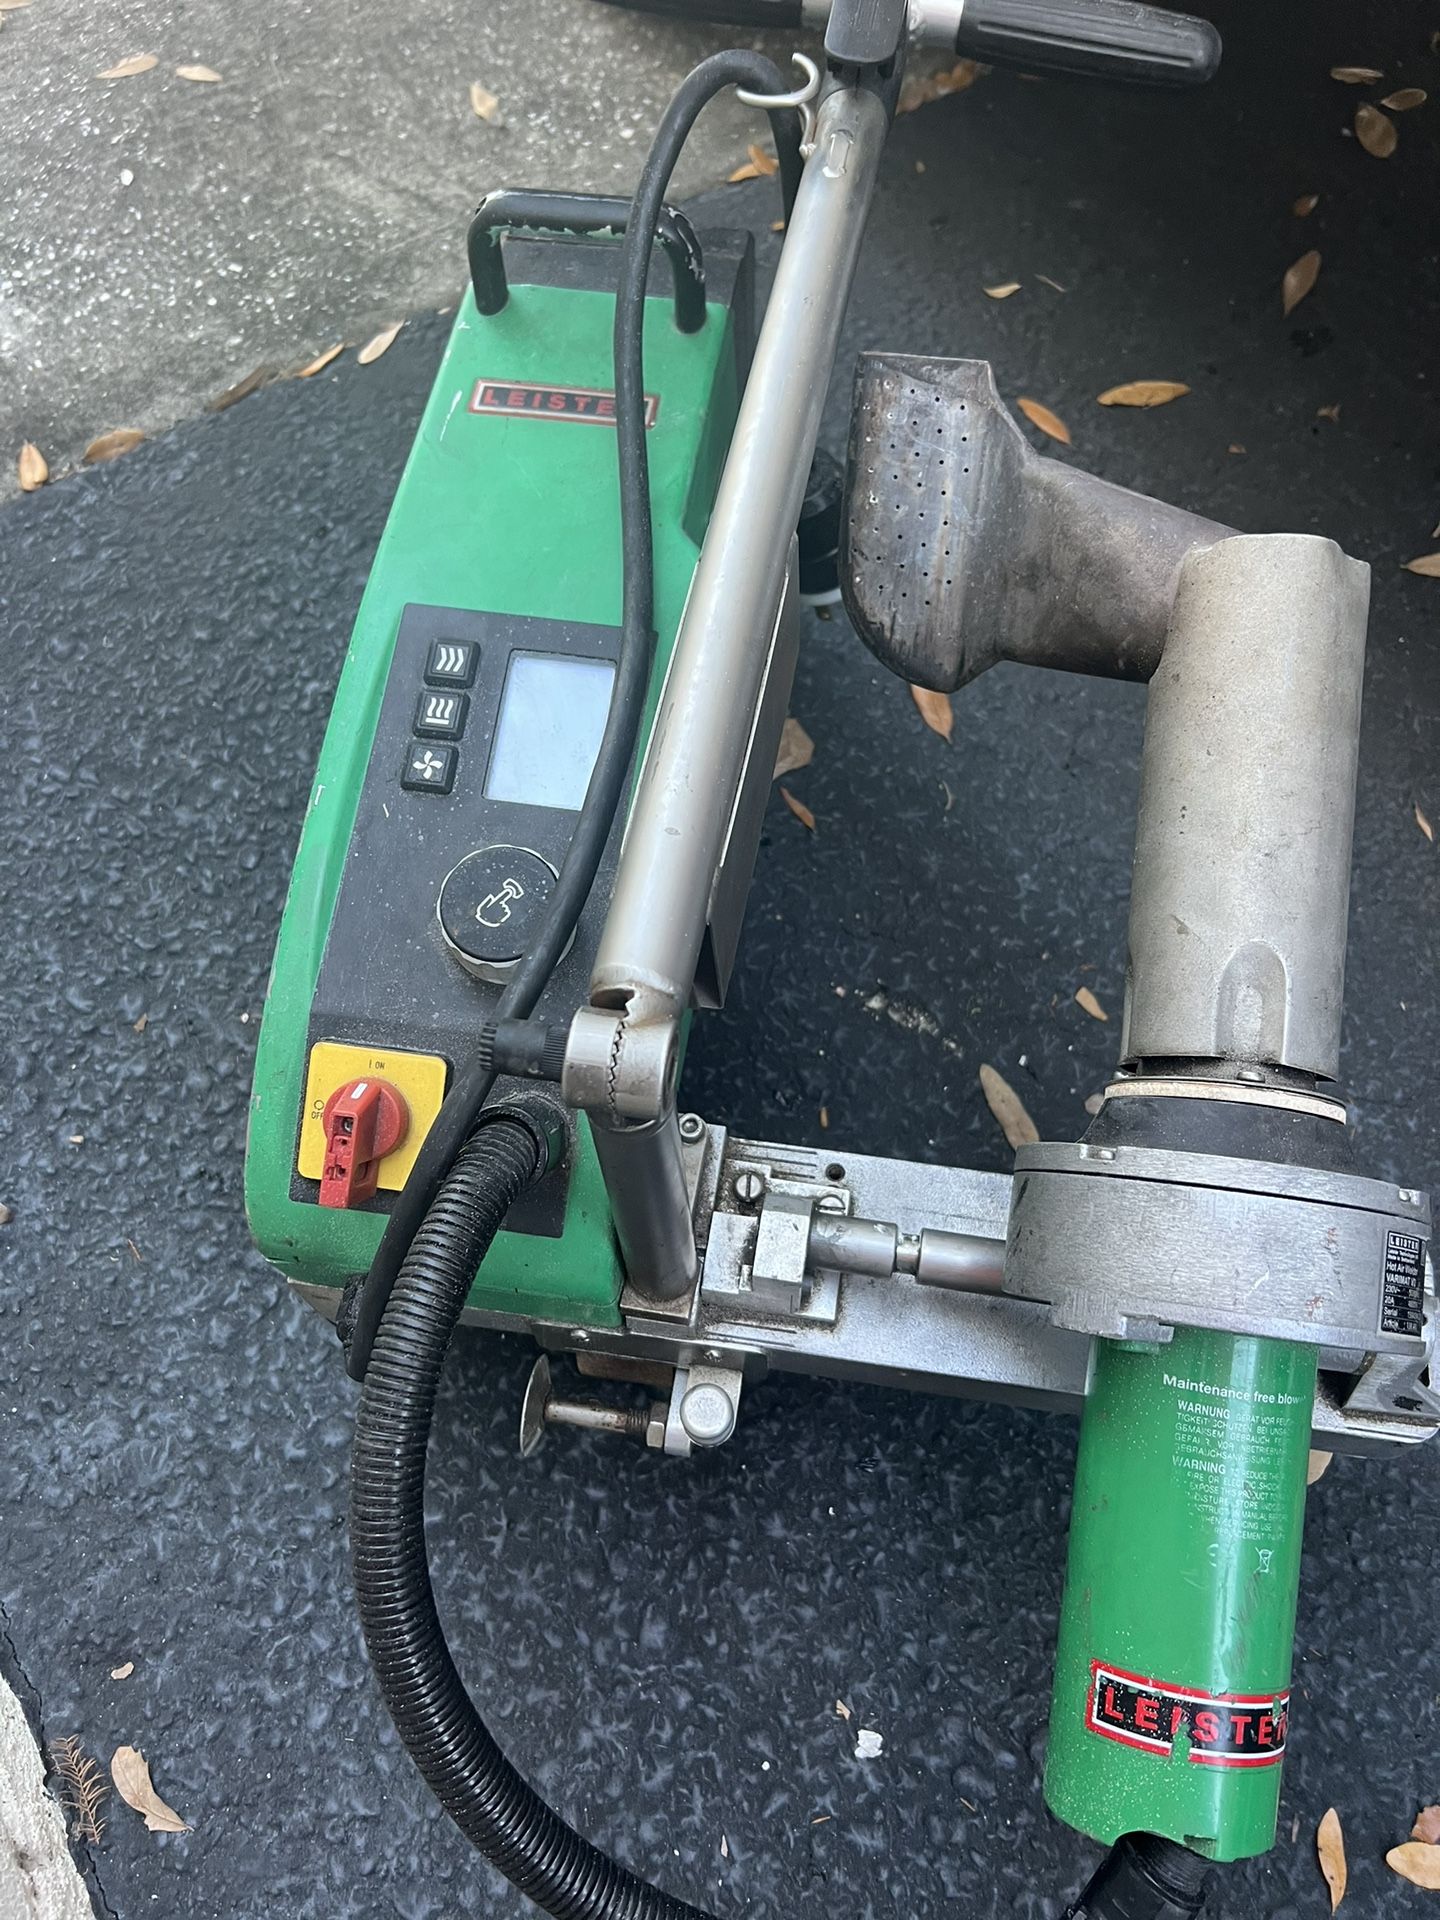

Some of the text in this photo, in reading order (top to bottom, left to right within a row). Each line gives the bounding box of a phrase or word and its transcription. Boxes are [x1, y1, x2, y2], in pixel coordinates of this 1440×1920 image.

[482, 388, 616, 416] LEISTE
[375, 1061, 386, 1070] ON
[1391, 1236, 1419, 1250] LEISTER
[1386, 1261, 1396, 1271] Hot
[1386, 1273, 1410, 1286] VARIMAT
[1163, 1373, 1251, 1401] Maintenance
[1253, 1391, 1275, 1404] free
[1177, 1399, 1231, 1419] WARNUNG
[1172, 1455, 1226, 1474] WARNING
